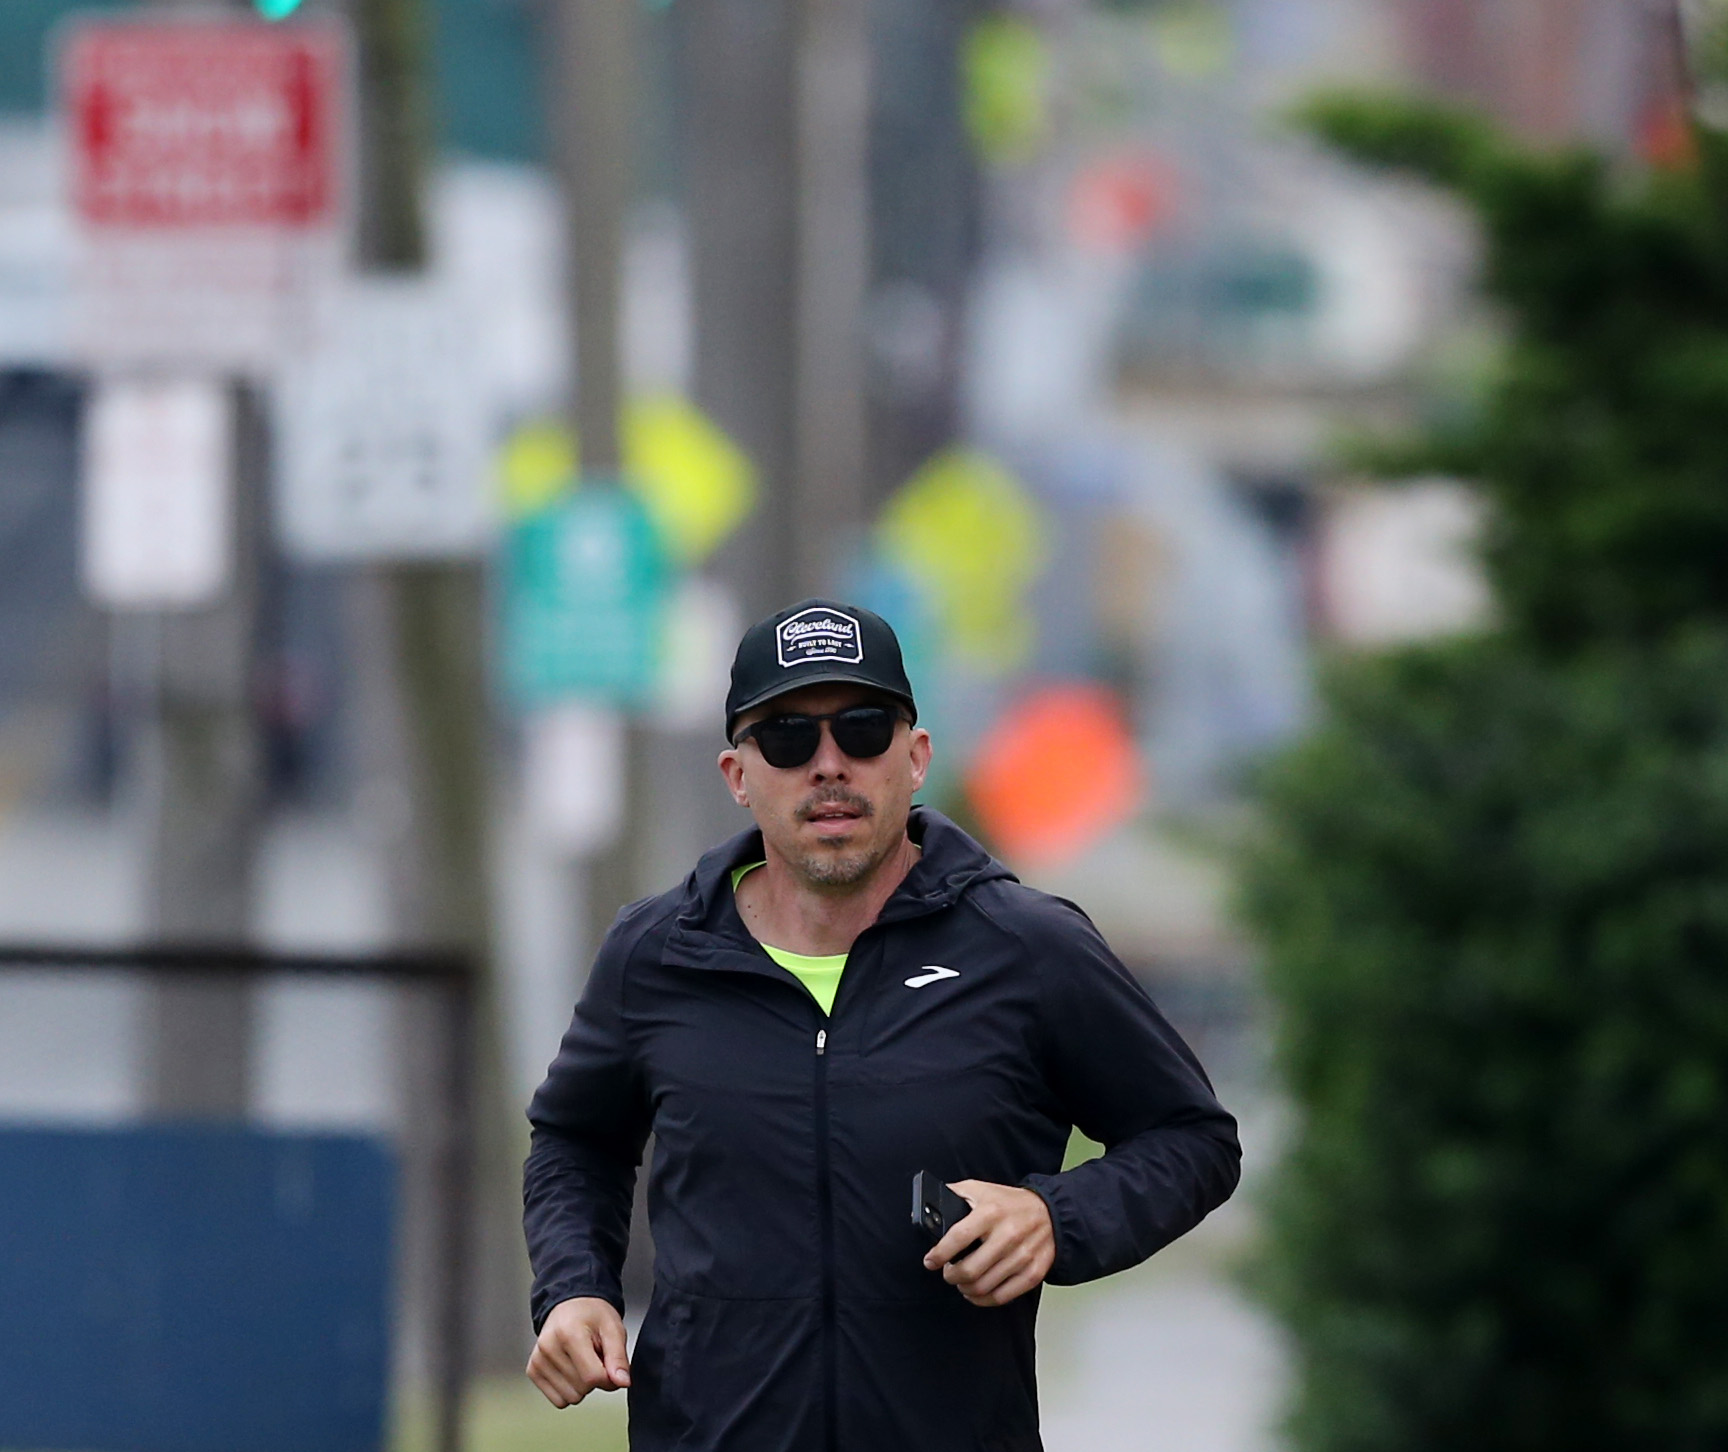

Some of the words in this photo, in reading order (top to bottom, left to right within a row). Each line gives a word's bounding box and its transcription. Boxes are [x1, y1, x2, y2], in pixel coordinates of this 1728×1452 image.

[783, 618, 853, 640] Cleveland
[798, 640, 817, 648] BUILT
[827, 639, 842, 648] LAST
